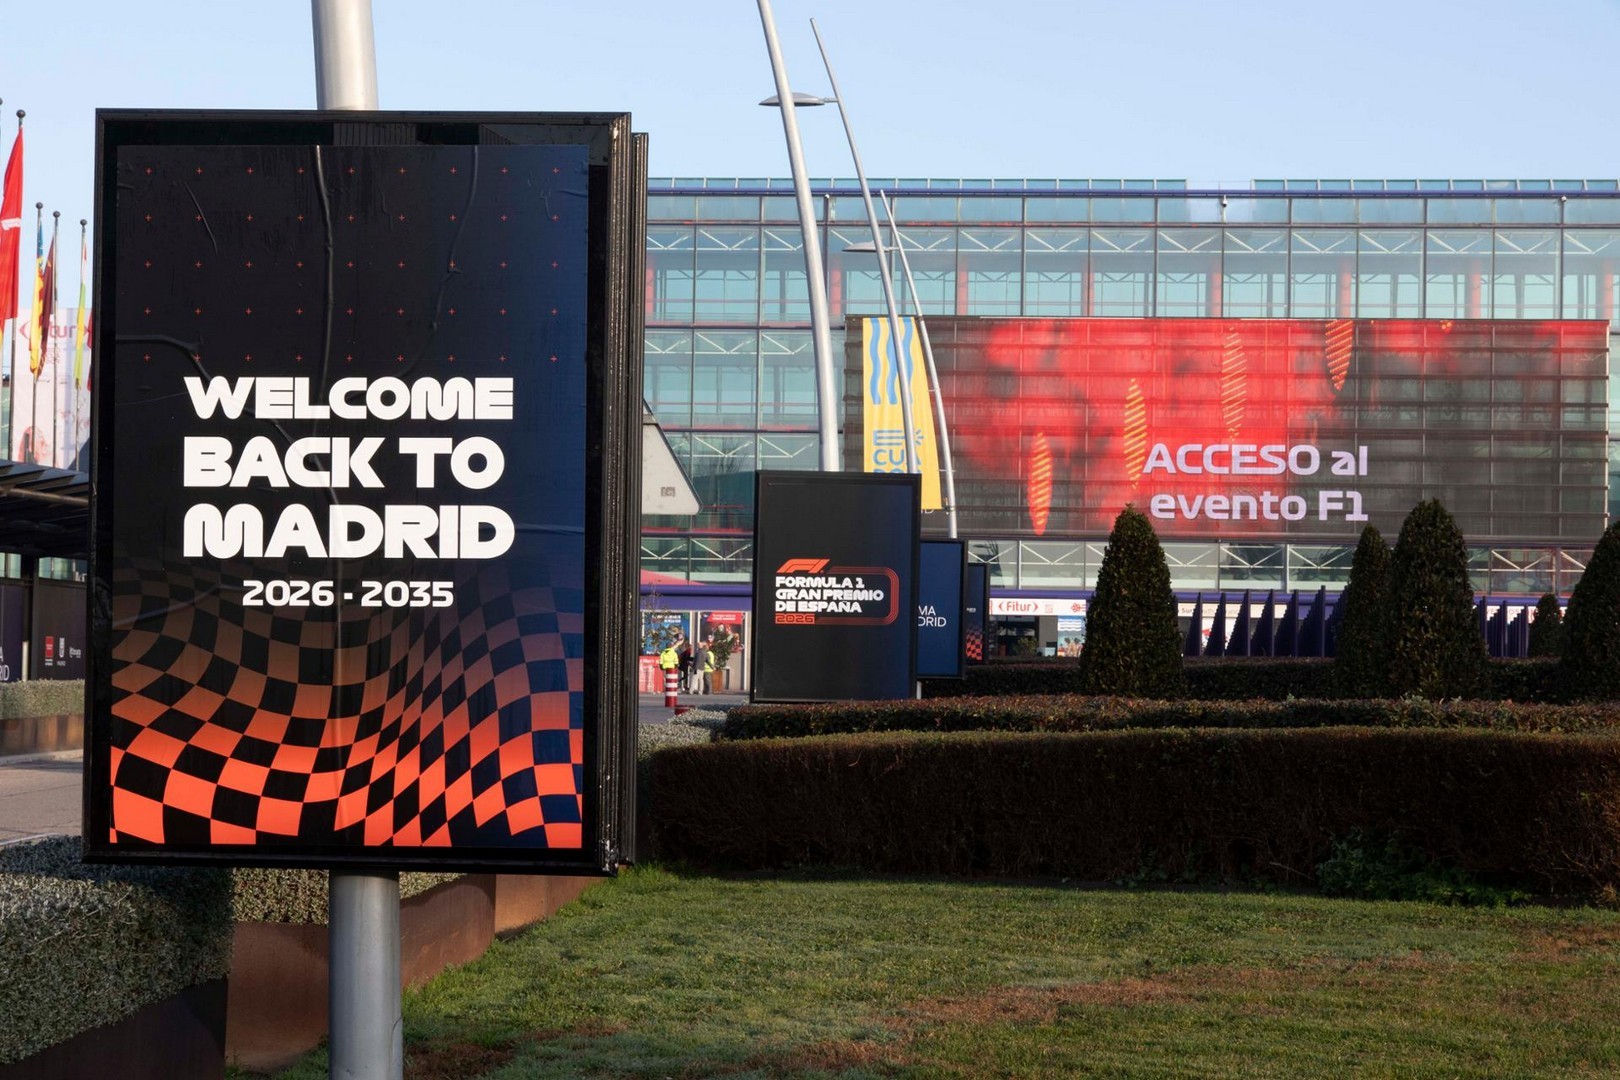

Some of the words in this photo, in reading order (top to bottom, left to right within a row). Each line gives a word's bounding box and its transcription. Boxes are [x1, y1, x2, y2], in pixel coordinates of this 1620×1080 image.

[183, 375, 514, 421] WELCOME
[183, 436, 386, 489] BACK
[399, 436, 505, 490] TO
[1143, 442, 1321, 475] ACCESO
[1331, 445, 1369, 476] al
[1150, 490, 1307, 520] evento
[1319, 490, 1369, 521] F1
[183, 503, 515, 559] MADRID
[242, 580, 334, 607] 2026
[361, 581, 454, 608] 2035
[775, 576, 853, 588] FORMULA
[856, 577, 865, 589] 1
[775, 588, 822, 600] GRAN
[823, 589, 884, 601] PREMIO
[775, 601, 796, 612] DE
[798, 601, 862, 613] ESPAÑA
[776, 614, 815, 624] 2026
